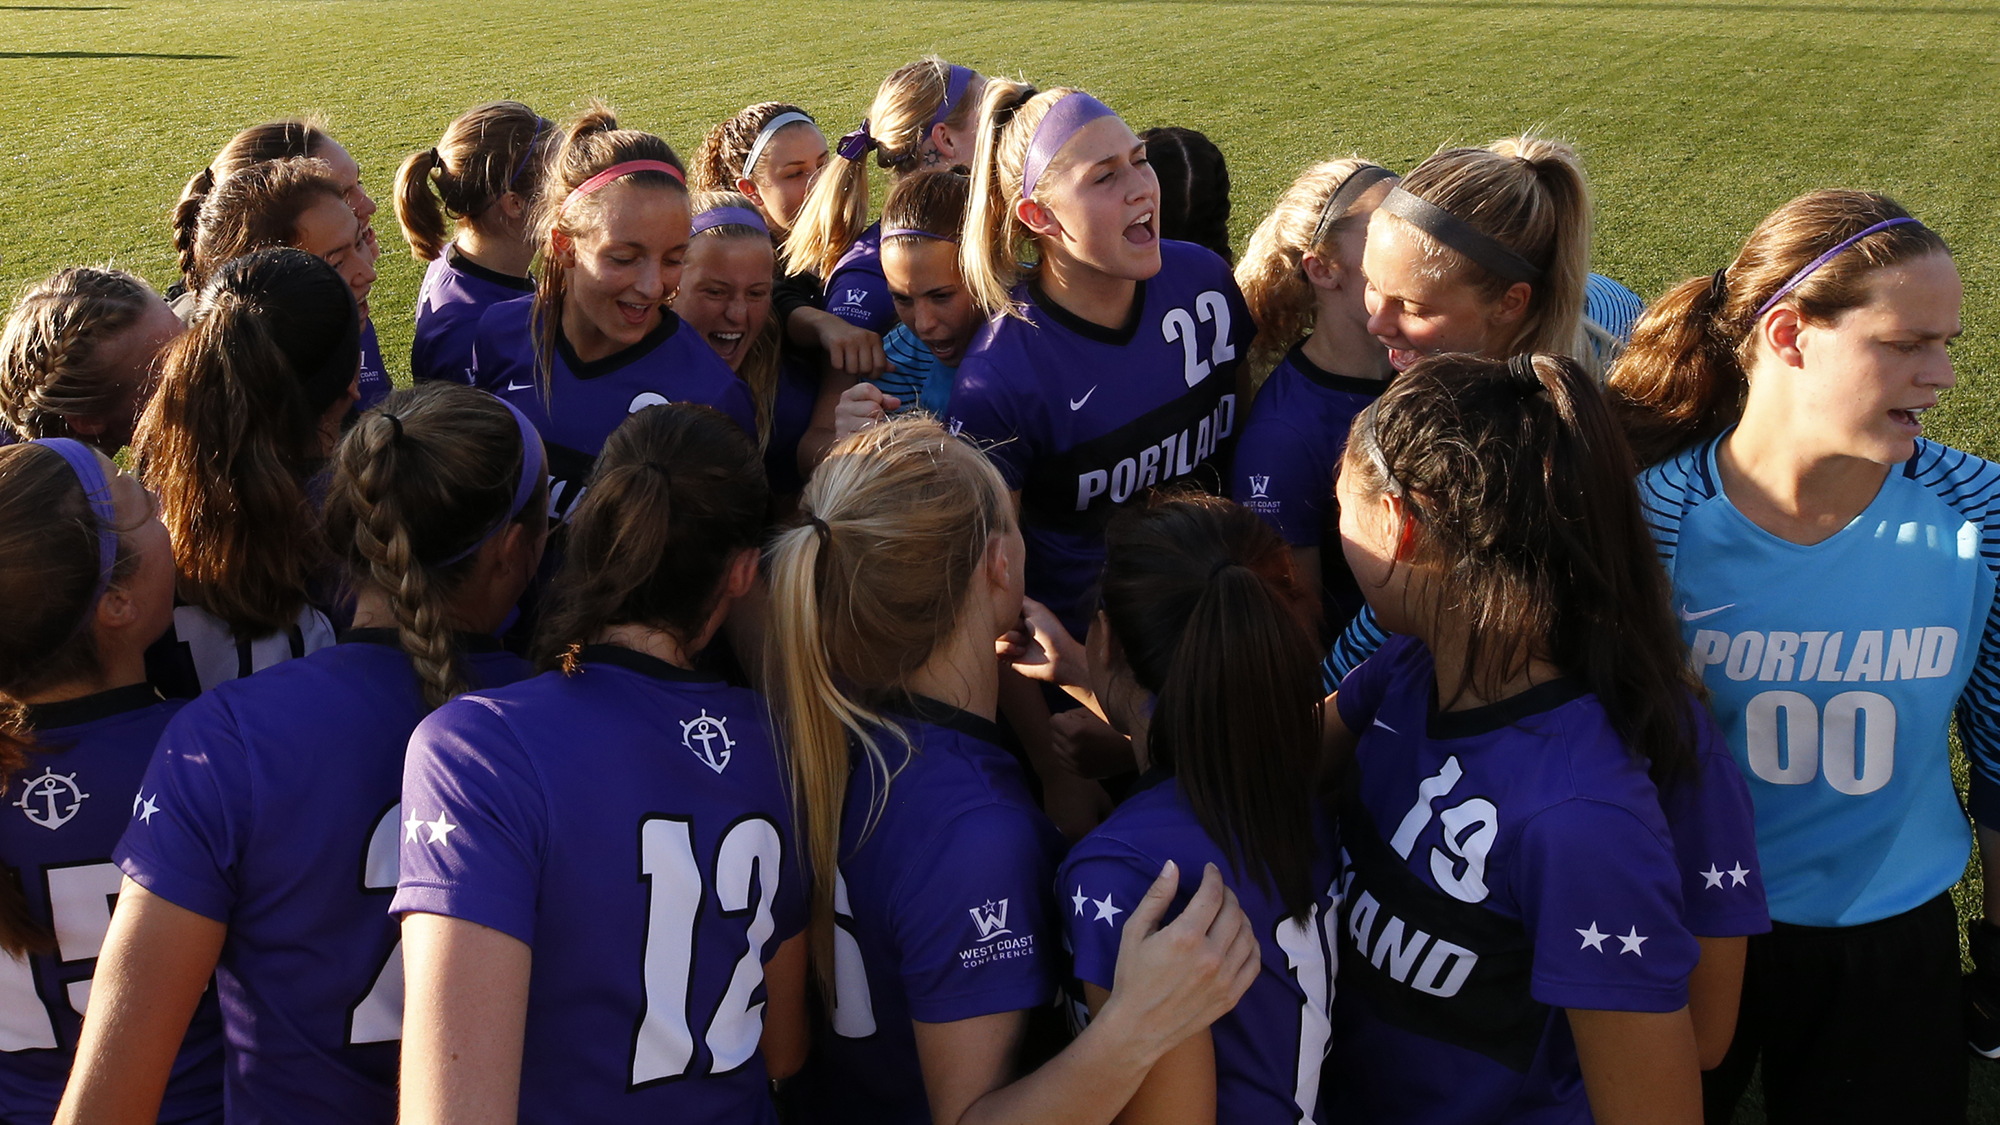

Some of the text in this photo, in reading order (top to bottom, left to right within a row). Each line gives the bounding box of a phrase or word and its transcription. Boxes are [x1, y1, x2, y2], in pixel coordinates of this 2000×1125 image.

[850, 307, 872, 316] COAST
[1161, 290, 1236, 388] 22
[1075, 393, 1236, 512] PORTLAND
[1257, 500, 1281, 508] COAST
[1690, 626, 1959, 682] PORTLAND
[1745, 690, 1897, 796] 00
[1390, 755, 1498, 904] 19
[631, 817, 783, 1087] 12
[959, 934, 1034, 960] WEST COAST
[963, 947, 1034, 969] CONFERENCE
